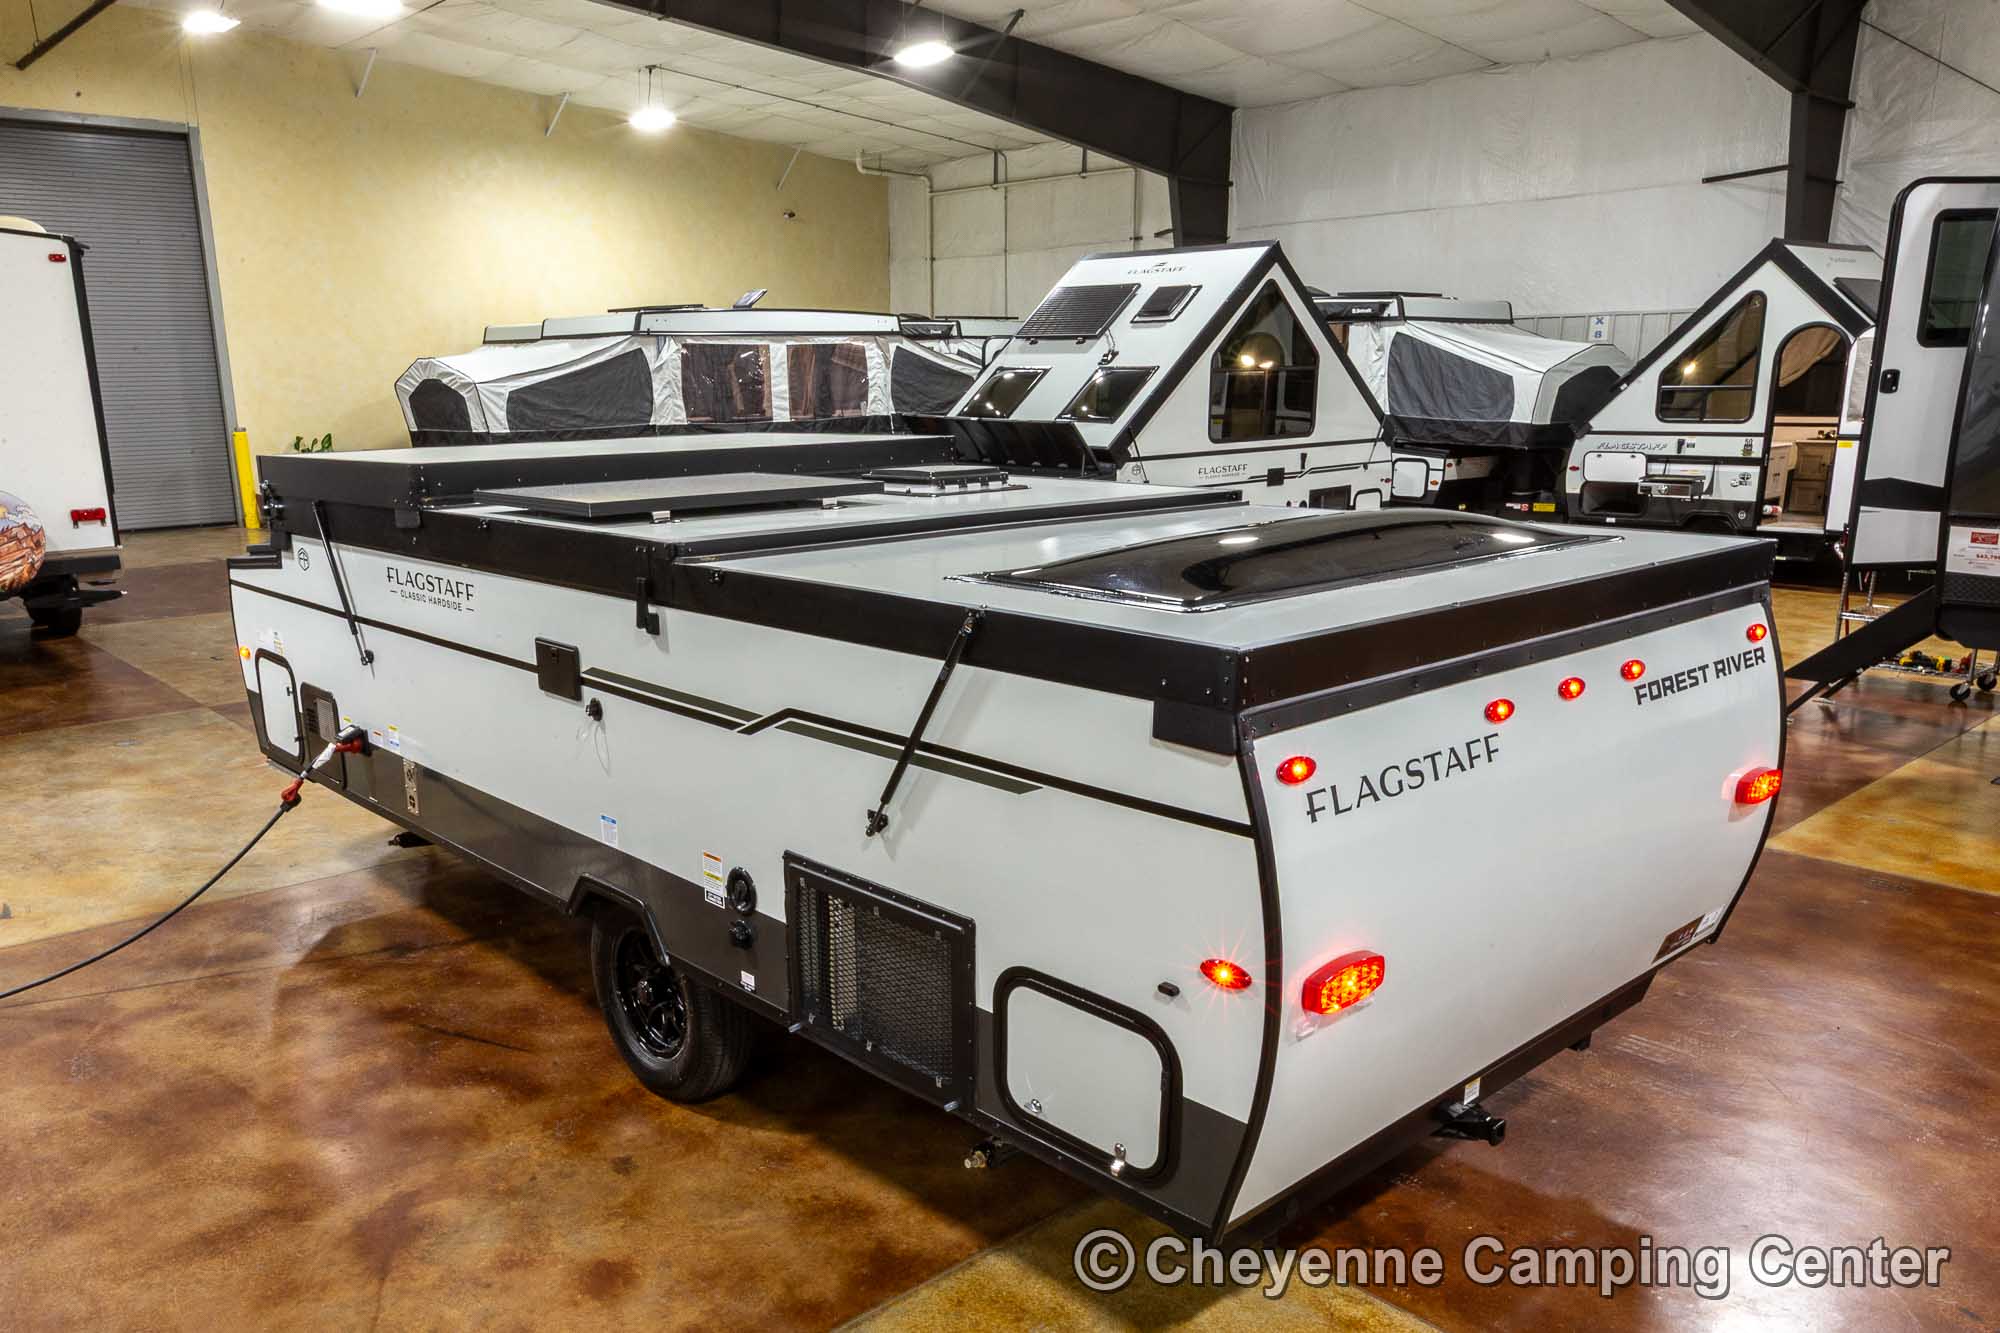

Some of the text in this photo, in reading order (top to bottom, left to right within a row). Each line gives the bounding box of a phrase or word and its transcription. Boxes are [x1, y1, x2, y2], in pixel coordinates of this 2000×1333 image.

[1198, 463, 1248, 474] FLAGSTAFF
[386, 566, 475, 601] FLAGSTAFF
[400, 589, 463, 611] CLASSIC HARDSIDE
[1633, 646, 1767, 706] FOREST RIVER
[1306, 732, 1500, 824] FLAGSTAFF
